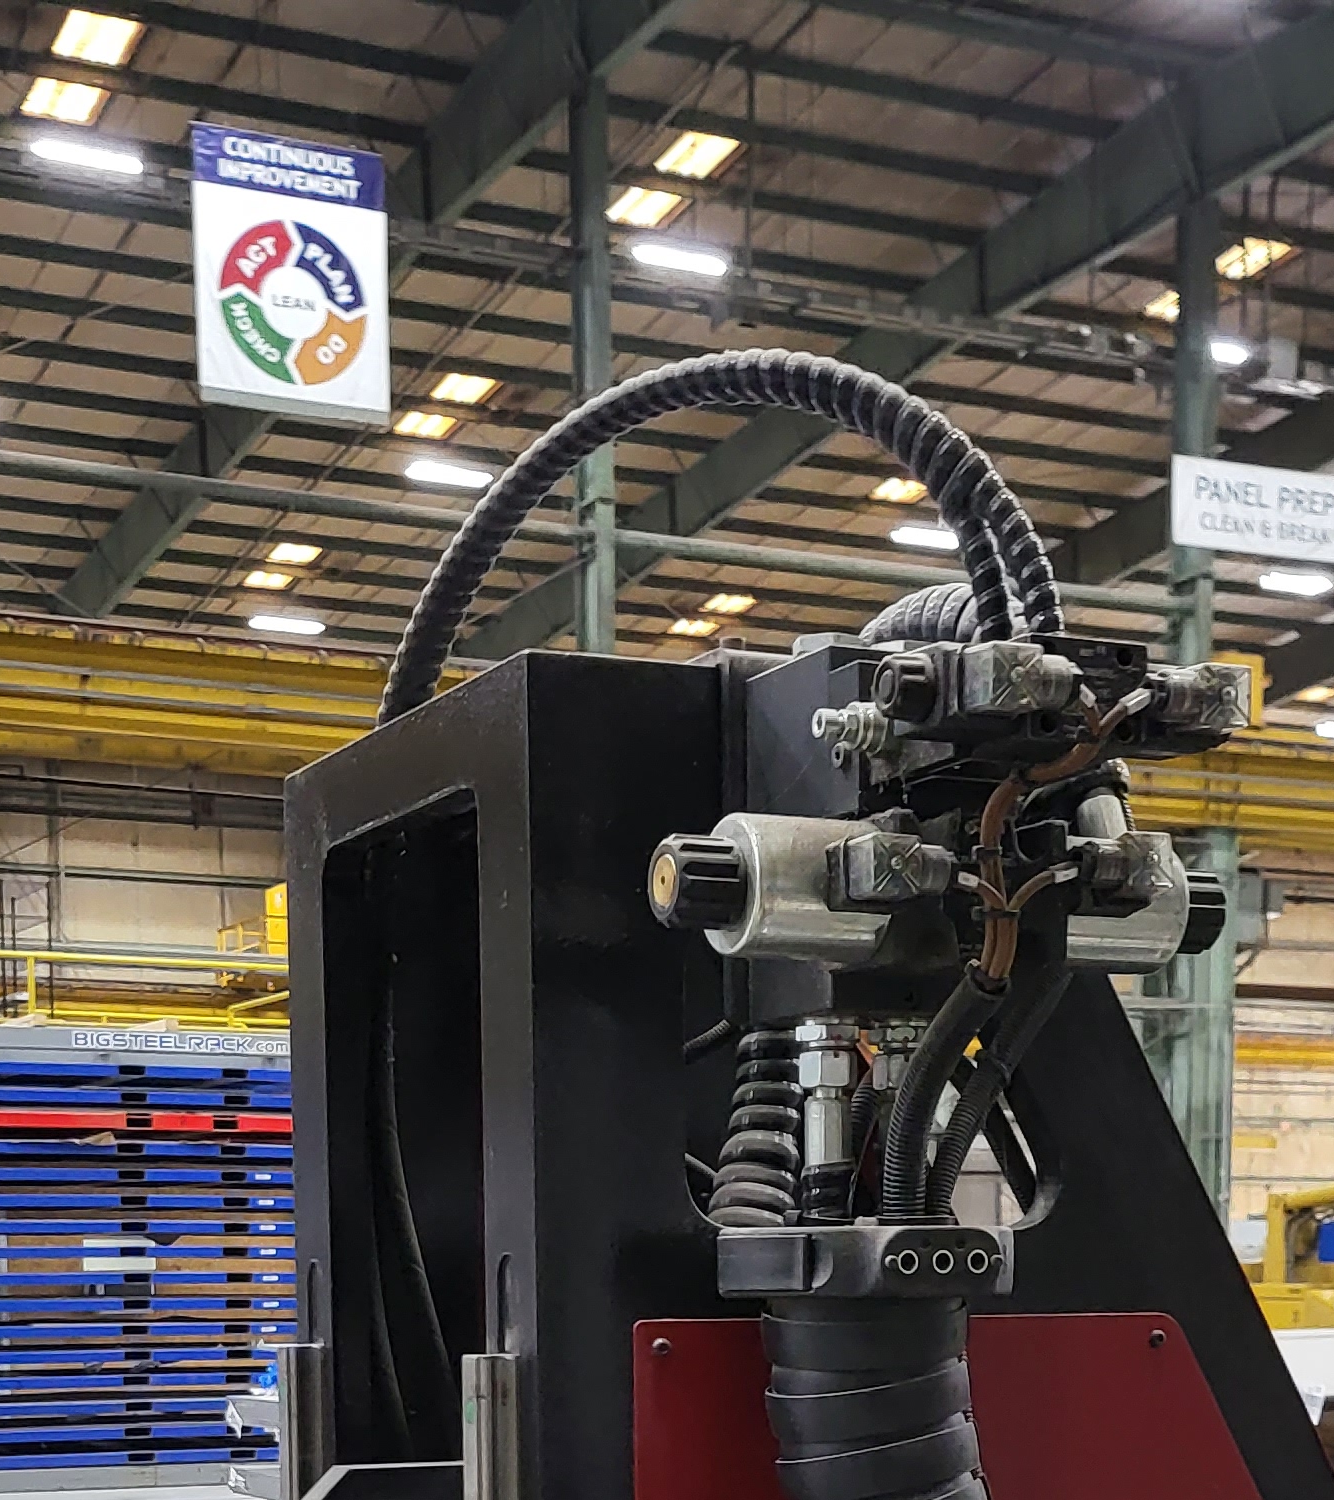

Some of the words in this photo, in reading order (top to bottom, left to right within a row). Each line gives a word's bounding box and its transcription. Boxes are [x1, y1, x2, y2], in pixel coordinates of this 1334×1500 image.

[223, 136, 356, 177] CONTINUOUS
[218, 158, 363, 200] IMPROVEMENT
[234, 235, 277, 279] ACT
[303, 242, 356, 305] PLAN
[1195, 475, 1271, 509] PANEL
[73, 1032, 288, 1053] BIGSTEELRACK.com
